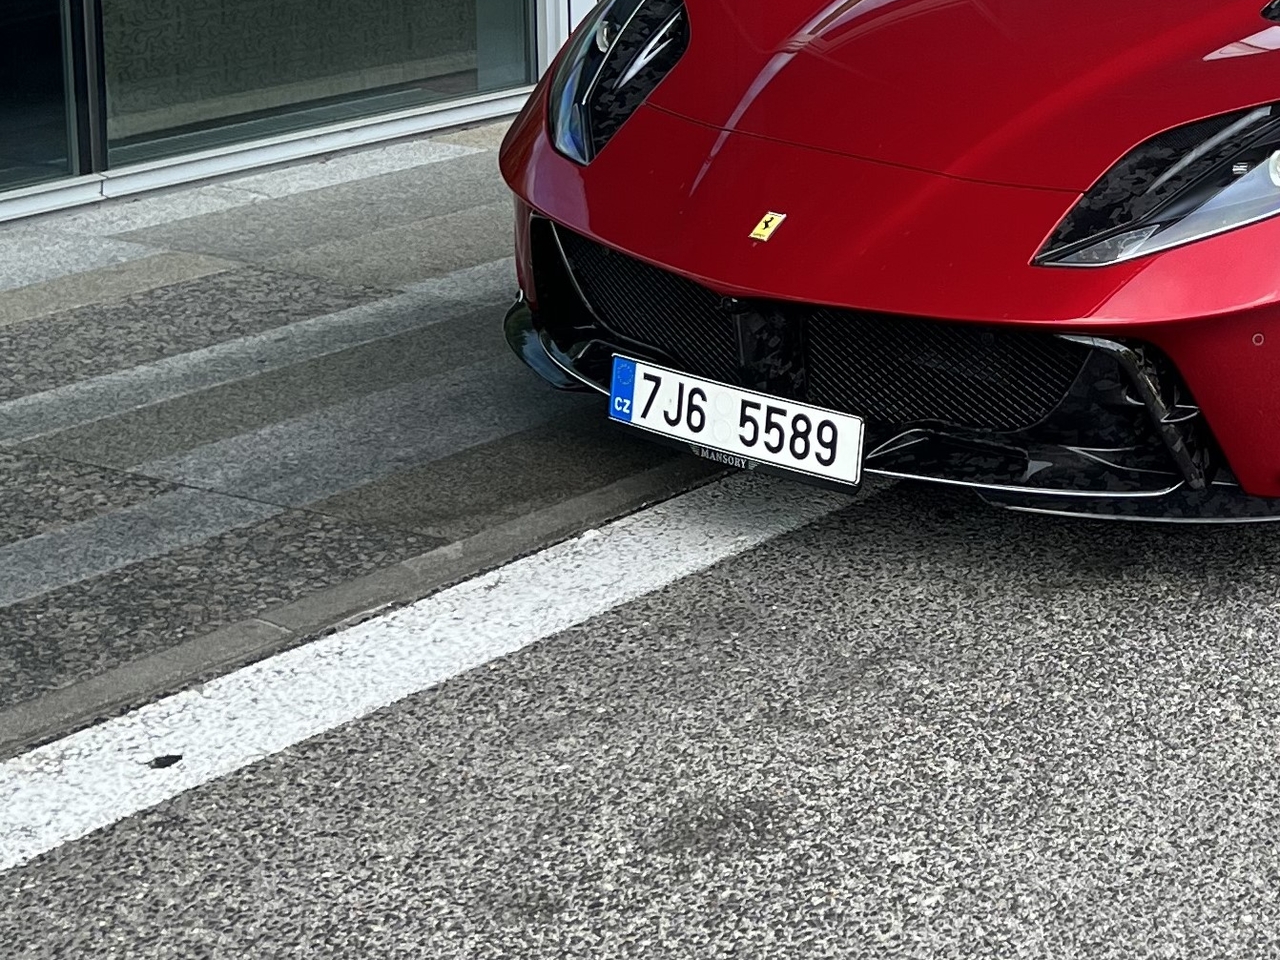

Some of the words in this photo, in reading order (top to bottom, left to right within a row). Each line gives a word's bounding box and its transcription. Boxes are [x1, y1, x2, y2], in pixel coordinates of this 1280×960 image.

[615, 397, 631, 413] CZ
[641, 372, 707, 433] 7J6
[739, 398, 838, 467] 5589
[700, 447, 747, 469] MANSORY
